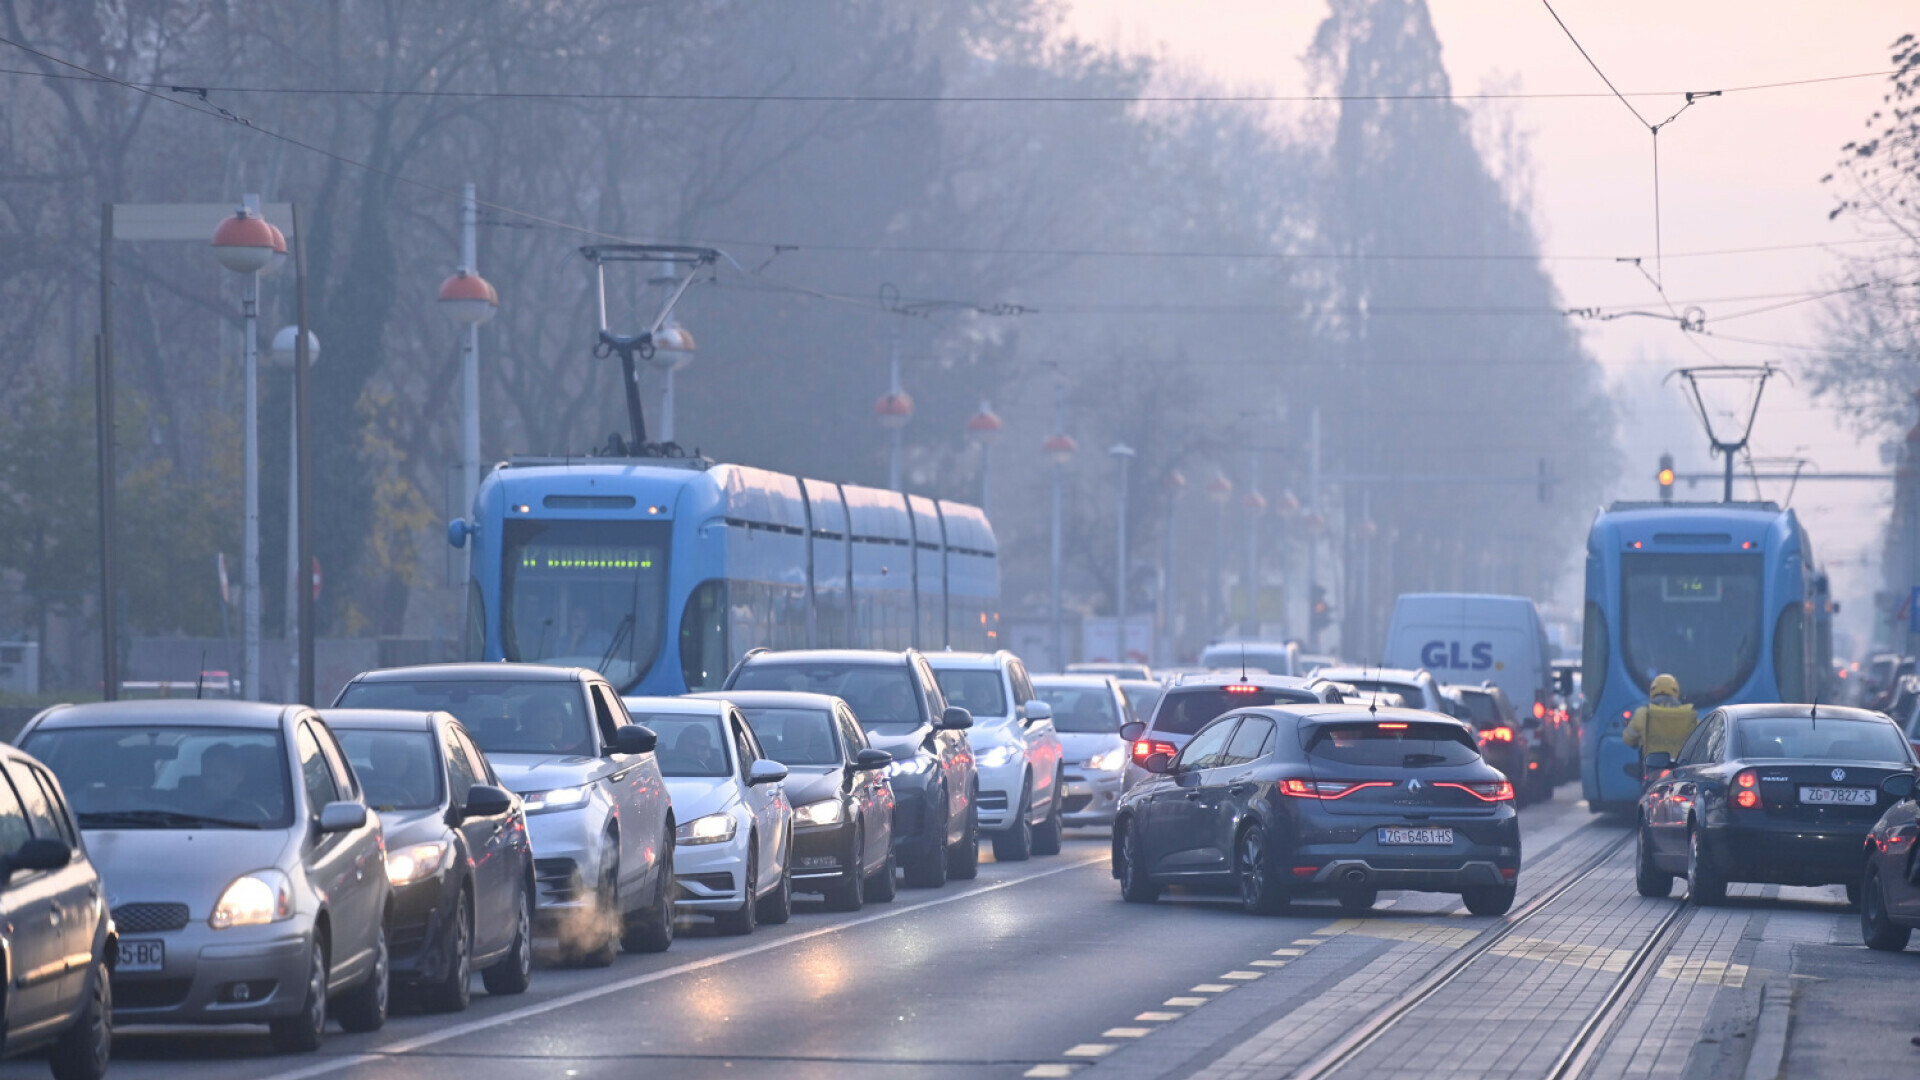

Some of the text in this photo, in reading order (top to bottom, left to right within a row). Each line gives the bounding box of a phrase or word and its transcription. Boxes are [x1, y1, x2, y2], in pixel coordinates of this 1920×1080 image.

[1809, 789, 1871, 802] ZG 7827-S
[1387, 830, 1451, 843] ZG 6461-HS
